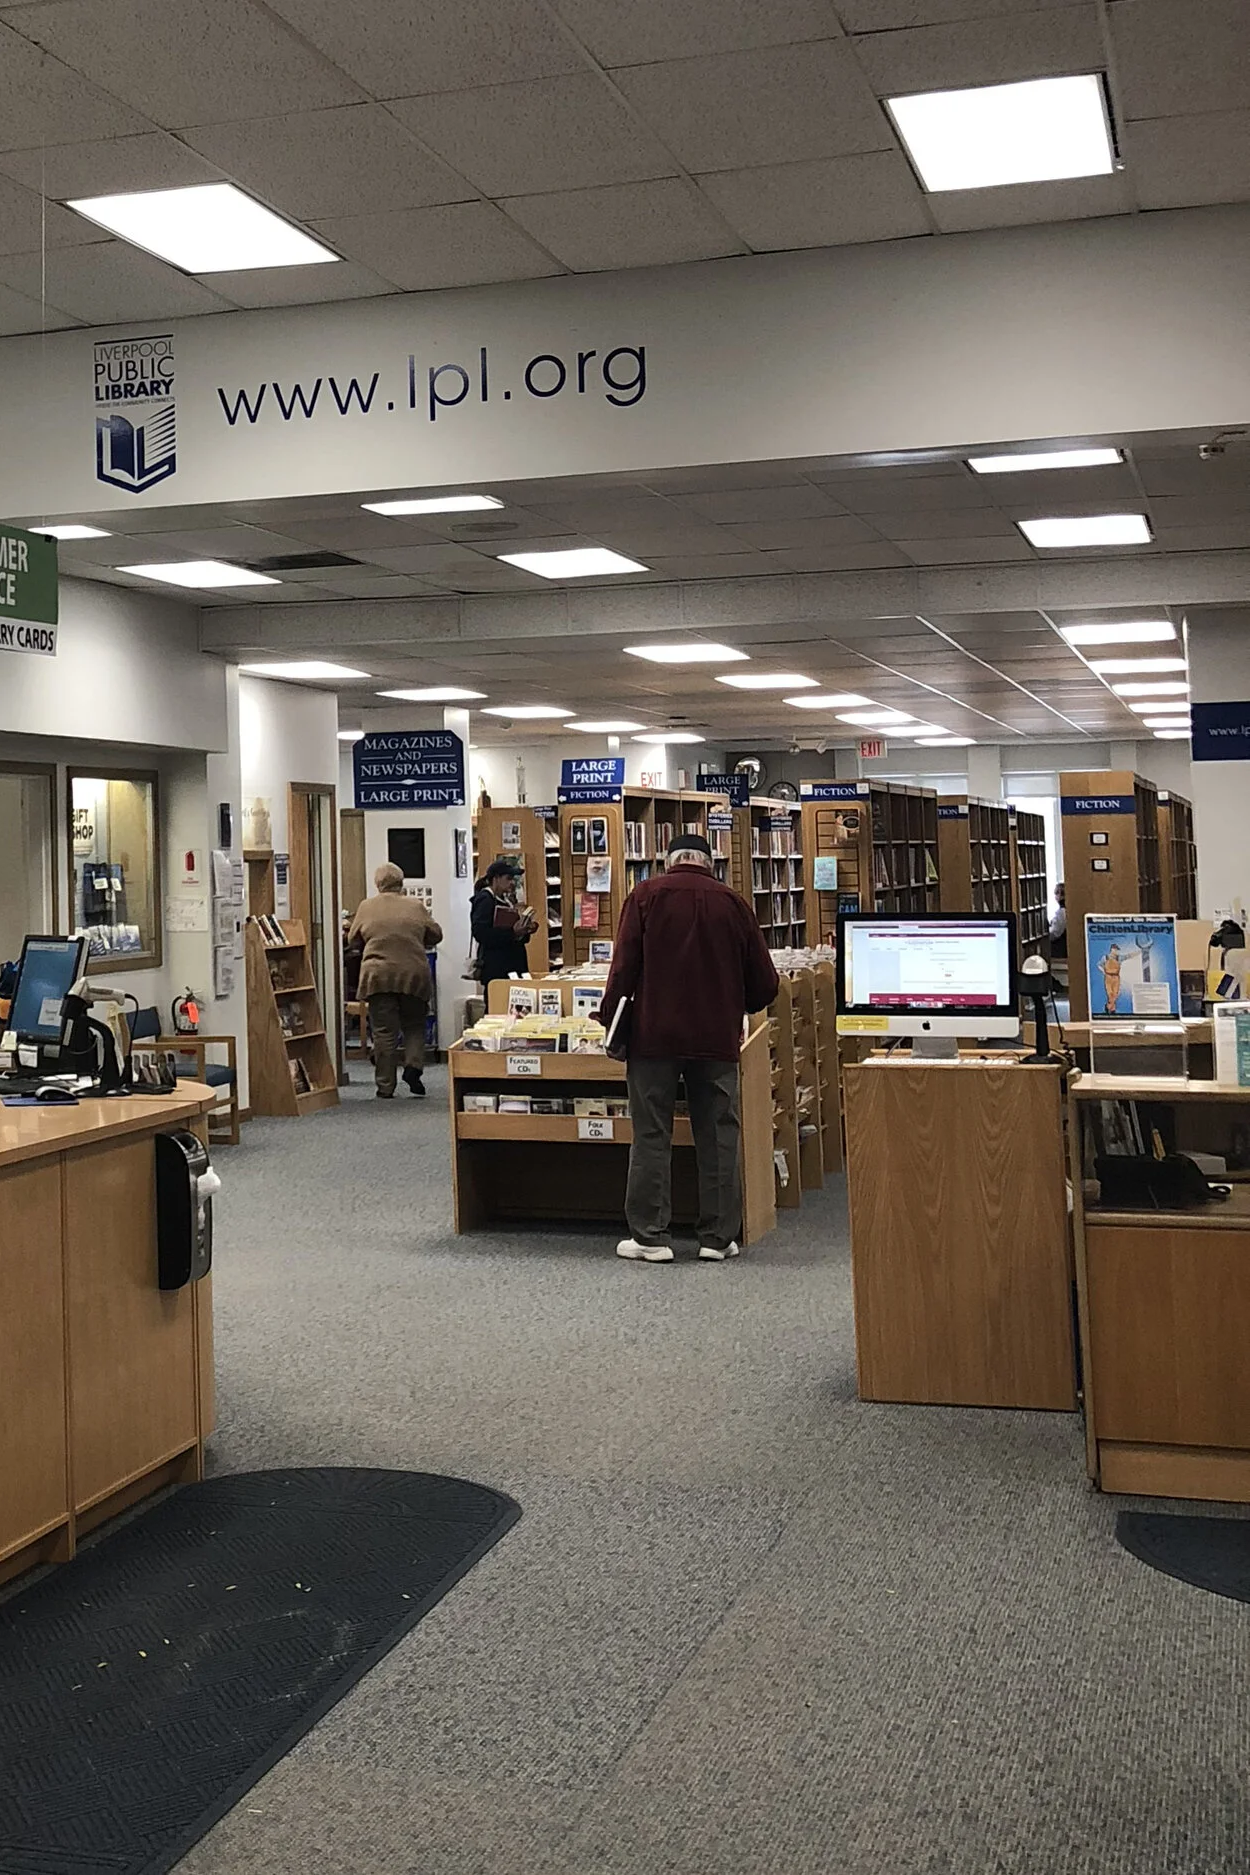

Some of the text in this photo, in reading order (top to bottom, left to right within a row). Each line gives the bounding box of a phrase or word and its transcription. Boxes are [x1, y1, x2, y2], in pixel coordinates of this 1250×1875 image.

[93, 341, 174, 363] LIVERPOOL
[94, 355, 175, 384] PUBLIC
[95, 378, 174, 402] LIBRARY
[217, 345, 646, 426] www.lpl.org
[16, 626, 54, 652] CARDS
[364, 735, 453, 750] MAGAZINES
[860, 741, 882, 757] EXIT
[395, 751, 422, 761] AND
[360, 761, 458, 777] NEWSPAPERS
[571, 760, 617, 772] LARGE
[572, 772, 615, 784] PRINT
[640, 771, 663, 788] EXIT
[703, 775, 741, 785] LARGE
[359, 788, 461, 803] LARGE PRINT
[569, 790, 610, 799] FICTION
[704, 786, 740, 795] PRINT
[813, 787, 856, 796] FICTION
[1075, 800, 1121, 809] FICTION
[937, 807, 958, 816] TION
[1088, 924, 1173, 934] ChiltonLibrary
